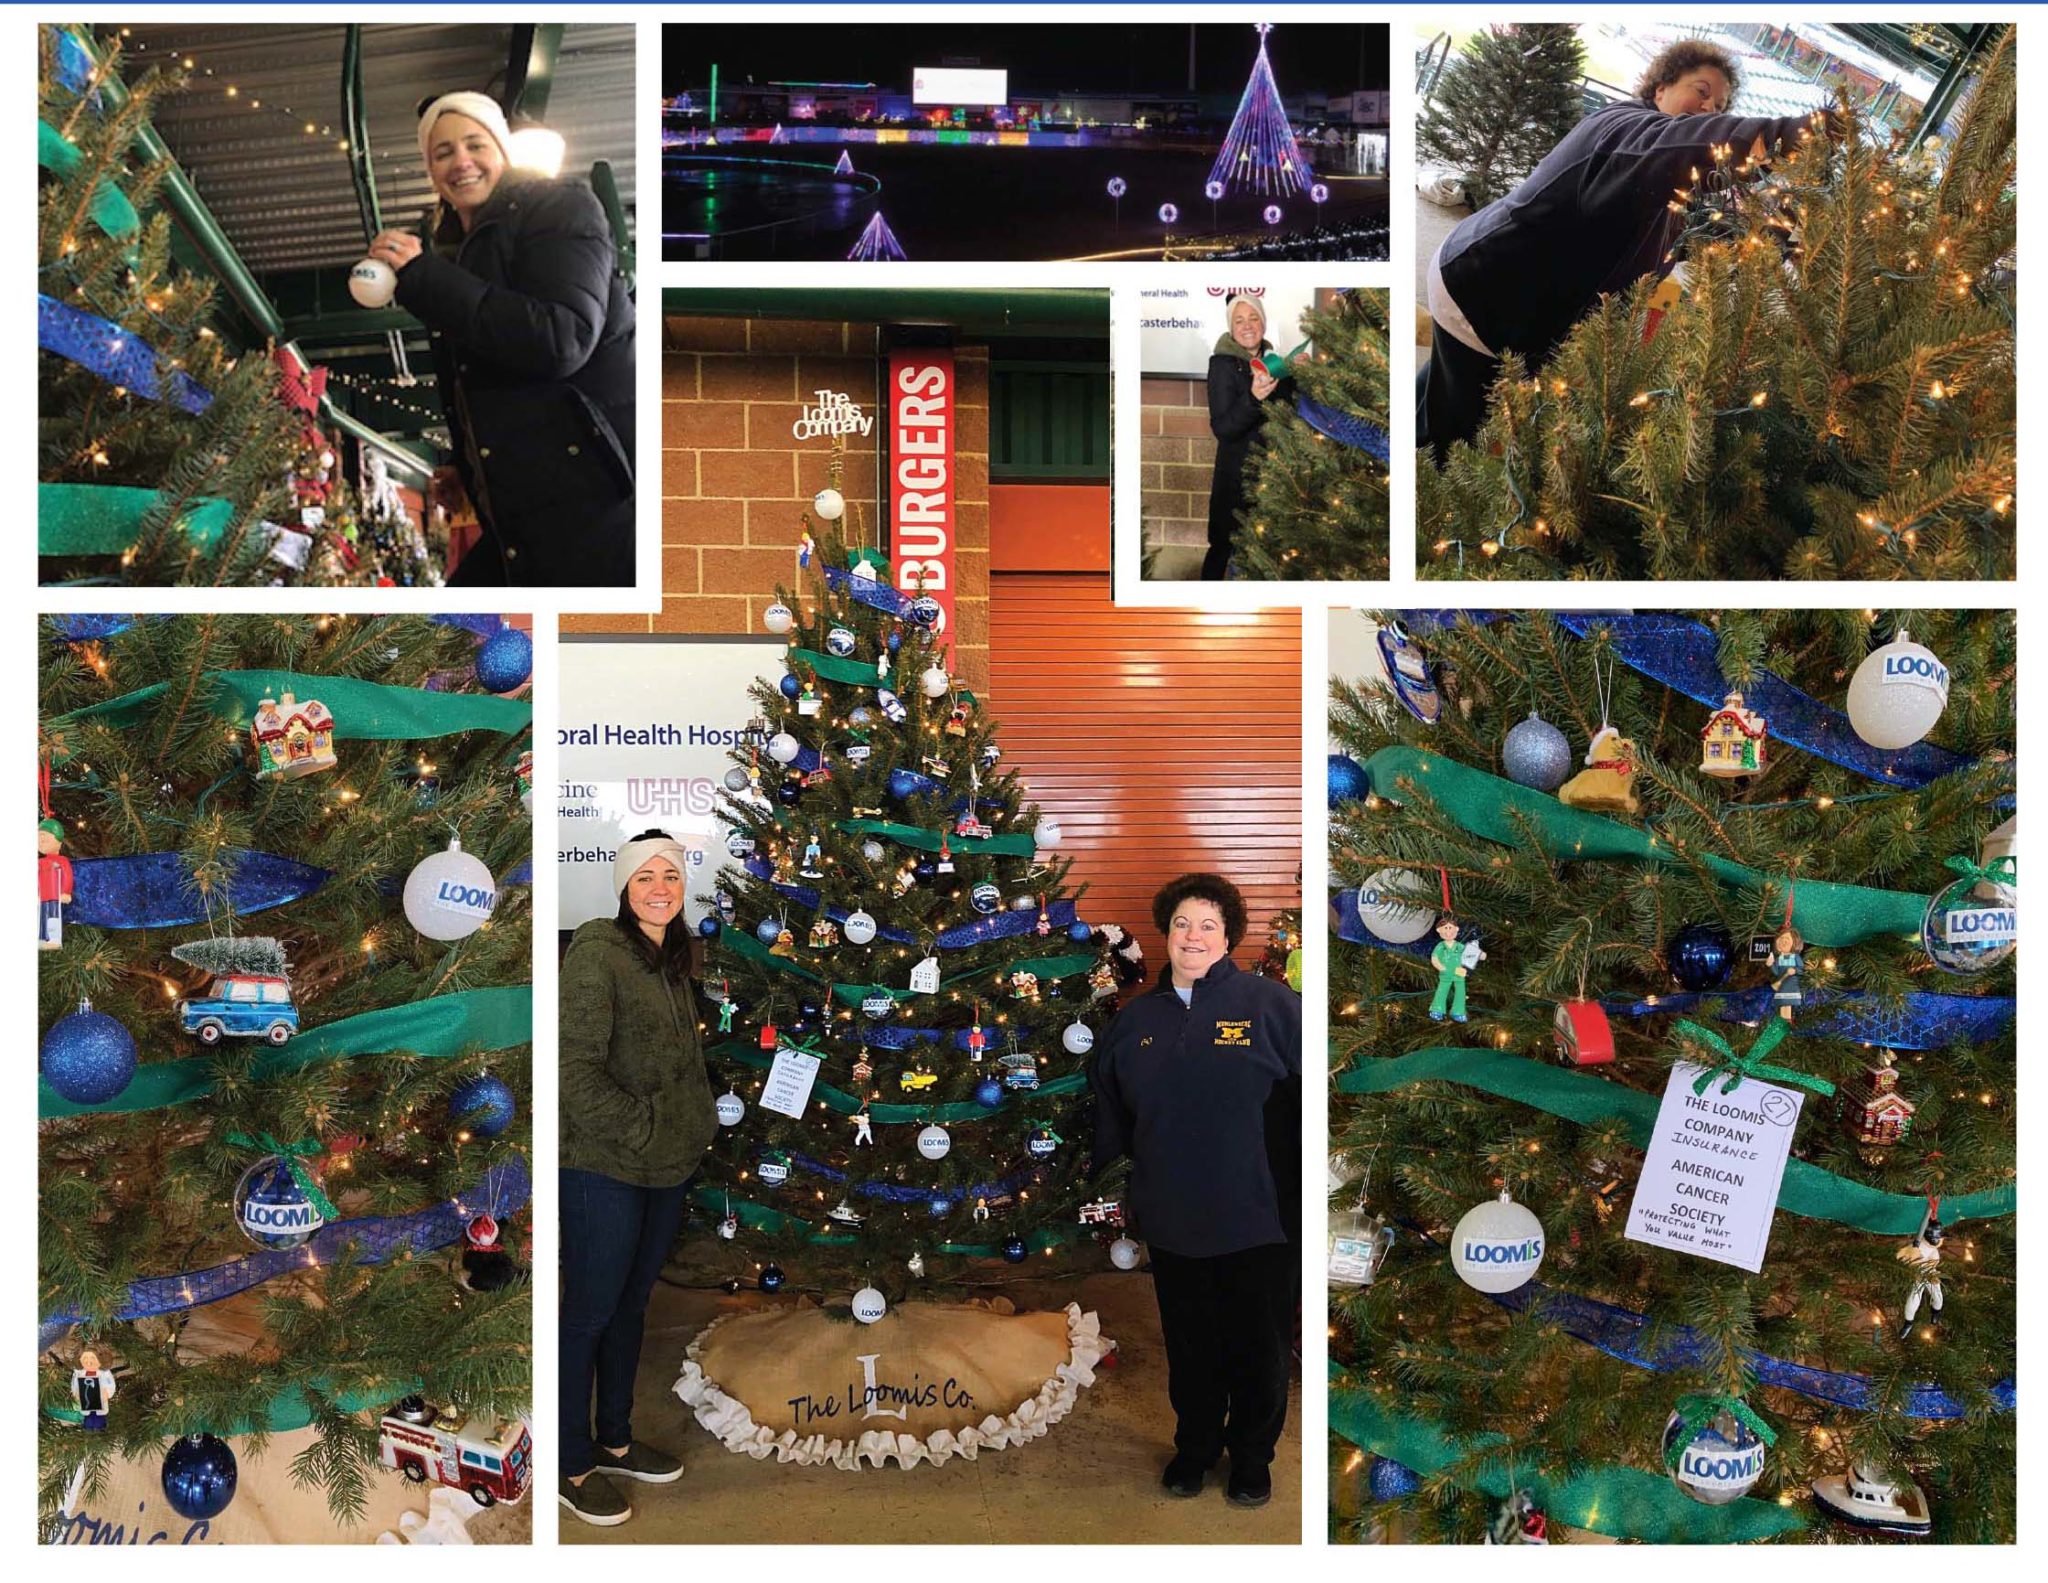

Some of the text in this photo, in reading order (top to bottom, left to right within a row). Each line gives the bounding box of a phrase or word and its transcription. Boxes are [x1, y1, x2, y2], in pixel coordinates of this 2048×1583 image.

[1161, 288, 1189, 297] Health
[814, 390, 850, 409] The
[792, 415, 873, 440] Company
[899, 366, 946, 590] BURGERS
[605, 724, 681, 745] Health
[627, 777, 716, 816] UHS
[1685, 1095, 1766, 1126] THE LOOMIS
[1764, 1095, 1791, 1119] 27
[1684, 1118, 1755, 1145] COMPANY
[1671, 1131, 1760, 1161] INSURANCE
[1671, 1159, 1745, 1187] AMERICAN
[1676, 1182, 1730, 1206] CANCER
[1669, 1202, 1726, 1227] SOCIETY
[1667, 1230, 1695, 1243] VALUE
[1704, 1226, 1731, 1238] WHAT
[788, 1373, 977, 1424] The Loomis Co.
[856, 1353, 907, 1421] L
